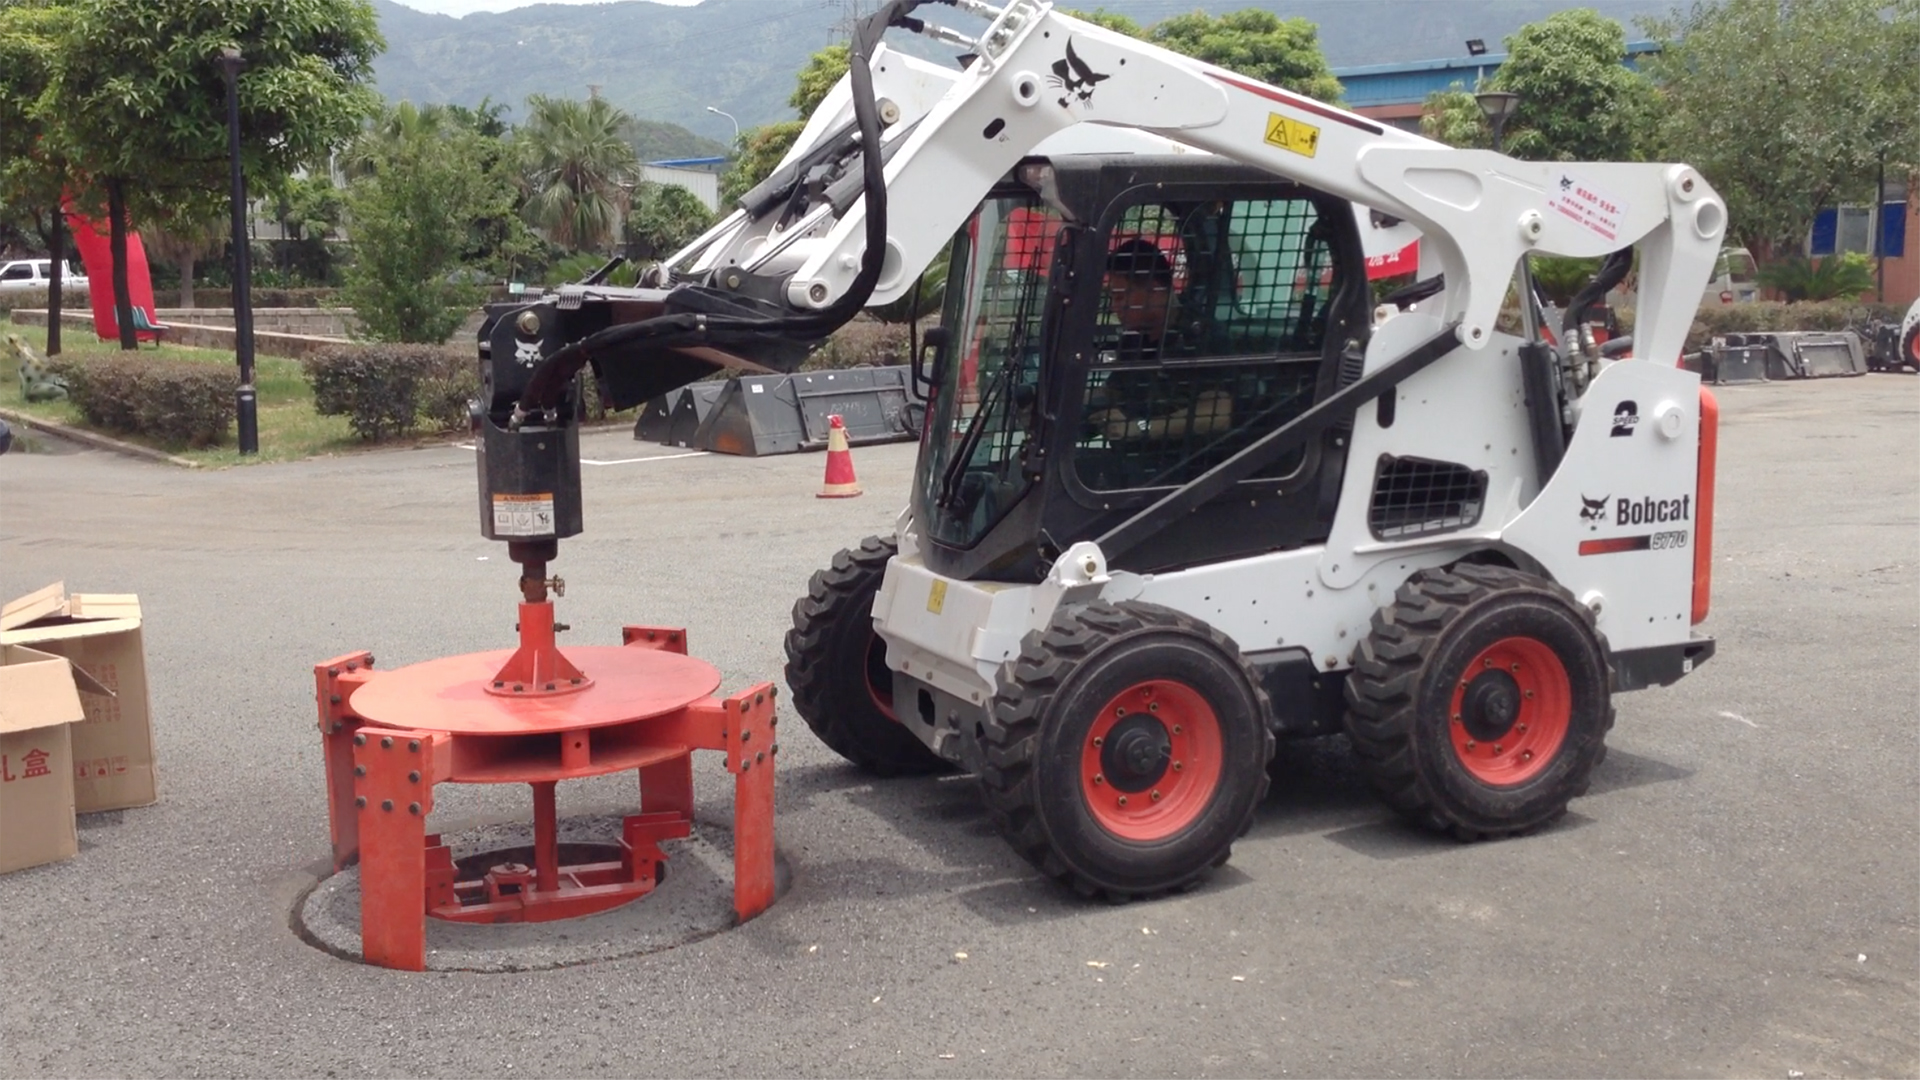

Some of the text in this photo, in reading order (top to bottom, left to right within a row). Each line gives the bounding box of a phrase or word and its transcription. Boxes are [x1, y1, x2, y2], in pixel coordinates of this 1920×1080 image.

[1610, 400, 1638, 438] 2
[1613, 416, 1639, 425] SPEED
[1616, 494, 1690, 526] Bobcat
[1652, 530, 1688, 550] S770
